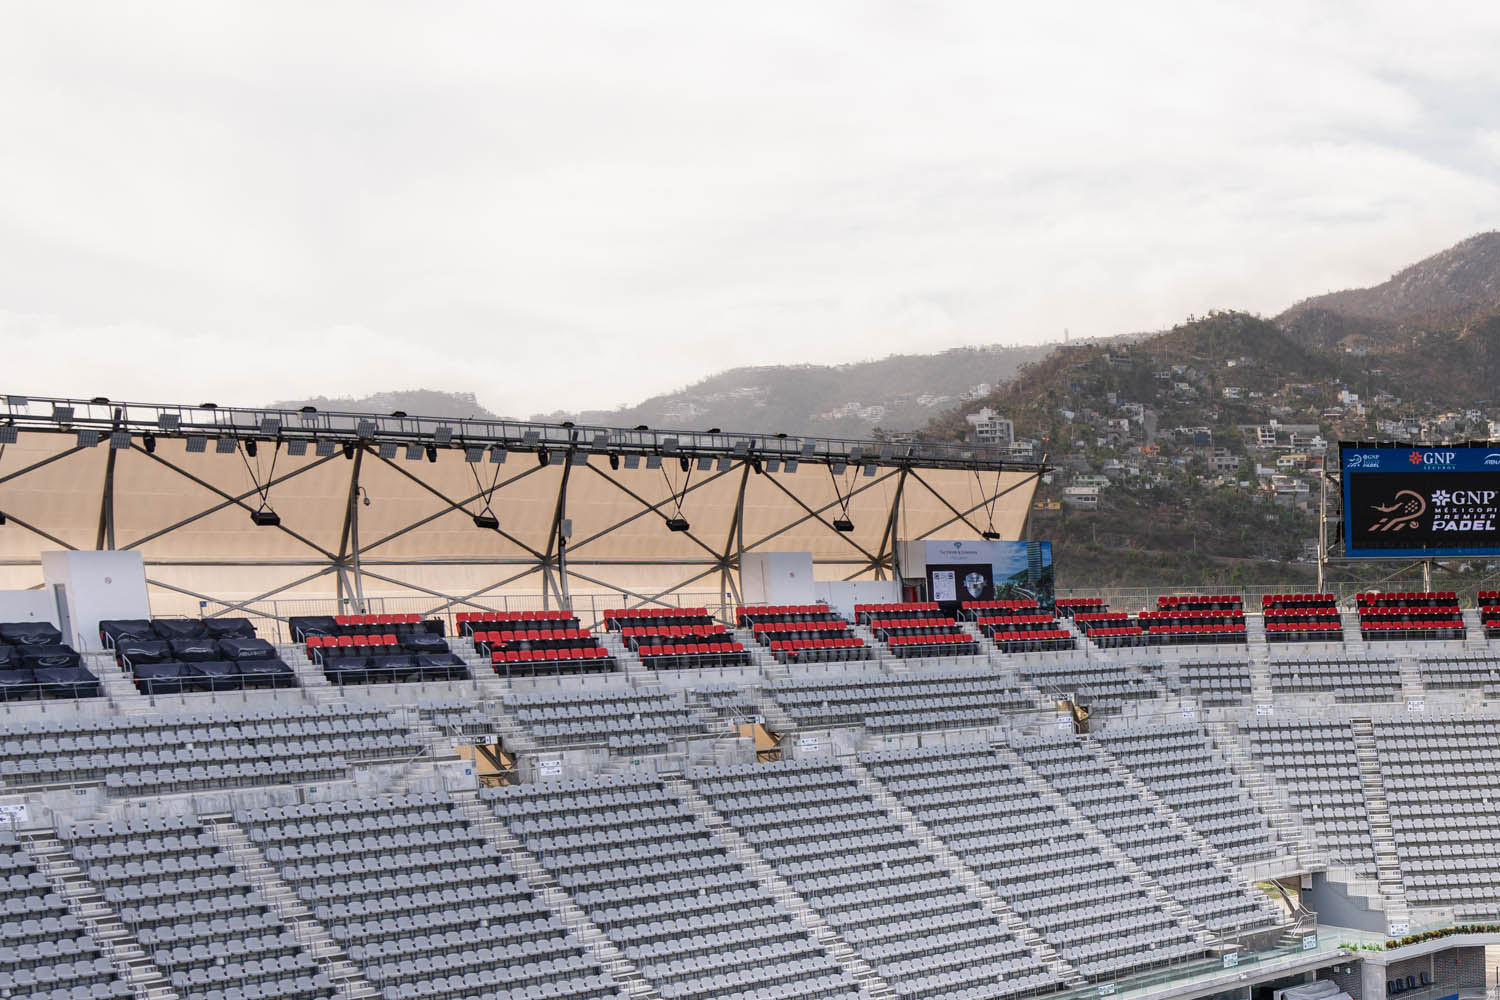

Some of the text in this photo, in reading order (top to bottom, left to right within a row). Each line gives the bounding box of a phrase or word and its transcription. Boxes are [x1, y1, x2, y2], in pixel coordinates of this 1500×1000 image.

[1424, 452, 1455, 464] GNP
[1452, 491, 1495, 505] GNP
[1432, 521, 1496, 531] PADEL
